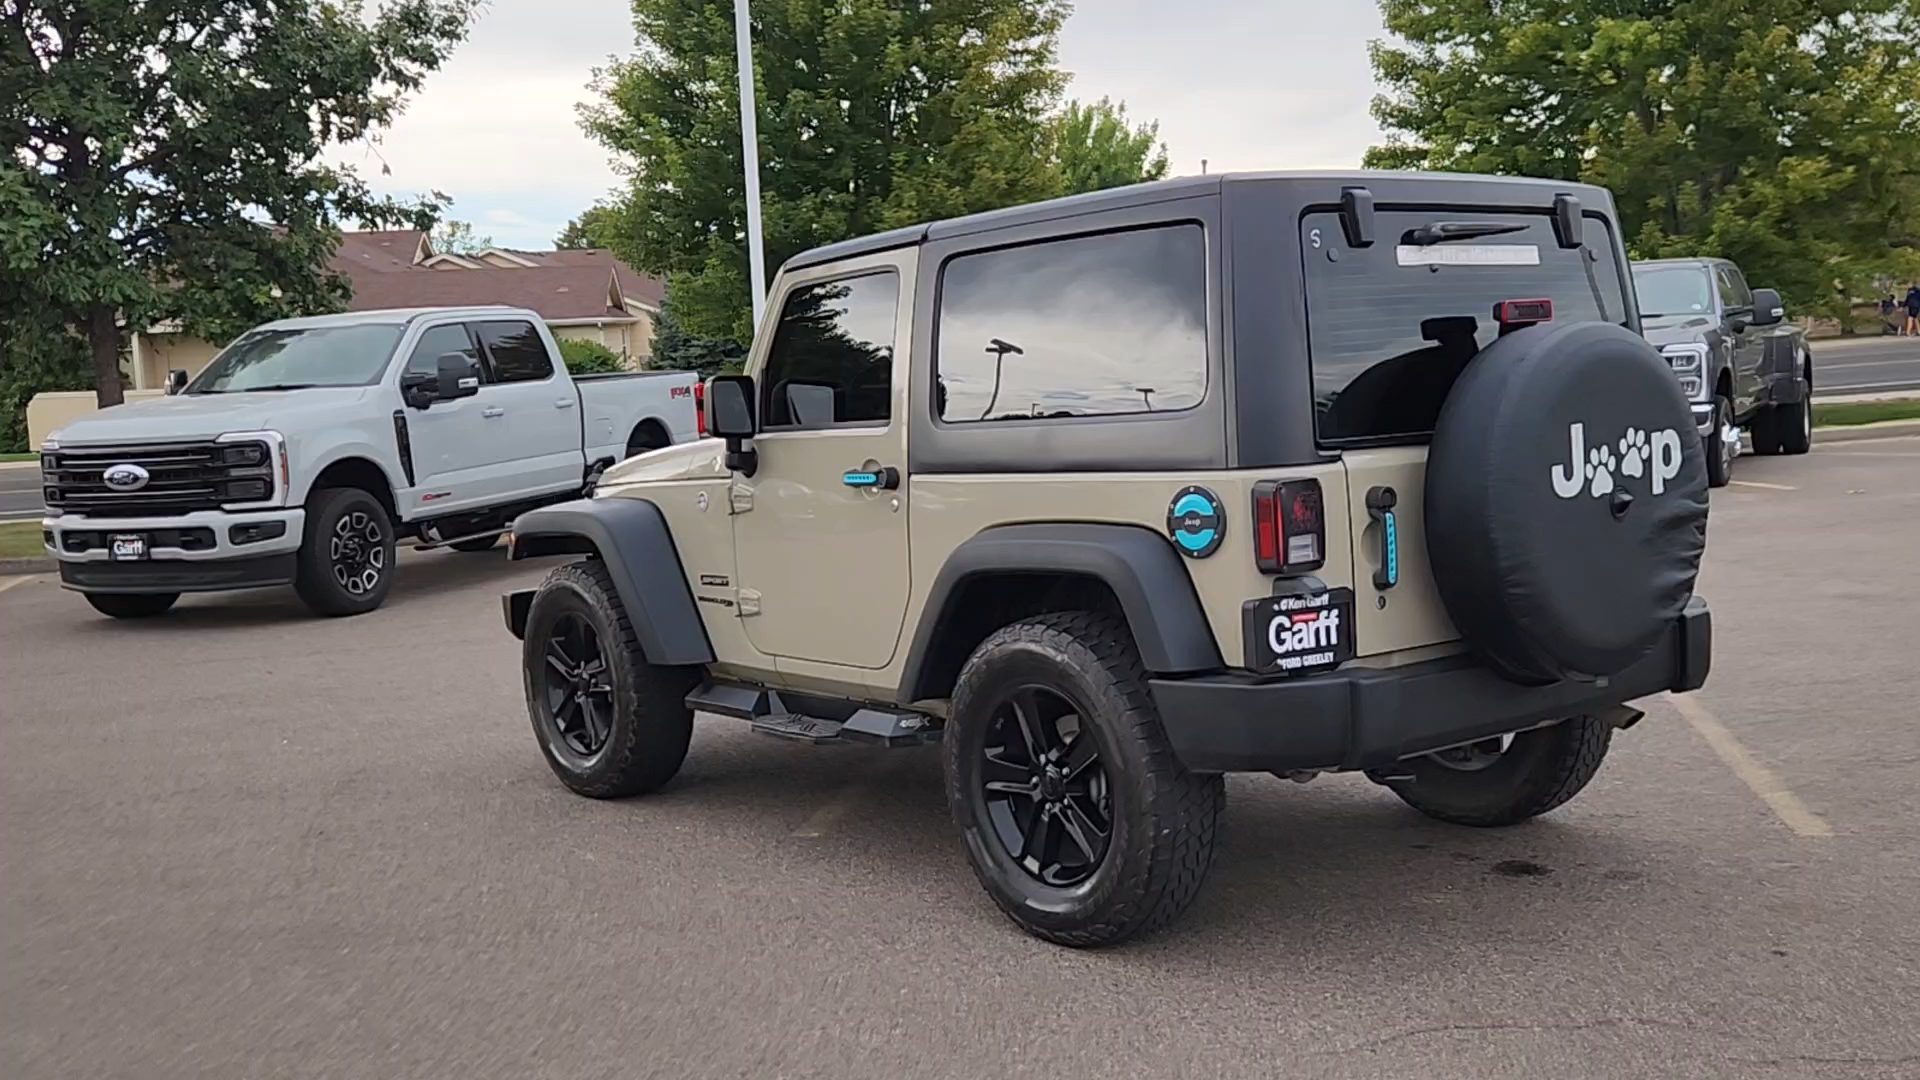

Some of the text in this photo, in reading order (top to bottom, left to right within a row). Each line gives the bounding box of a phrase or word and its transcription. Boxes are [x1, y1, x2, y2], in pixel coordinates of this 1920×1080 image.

[1310, 228, 1321, 248] S
[1551, 422, 1682, 498] Jp
[1268, 608, 1340, 654] Garff
